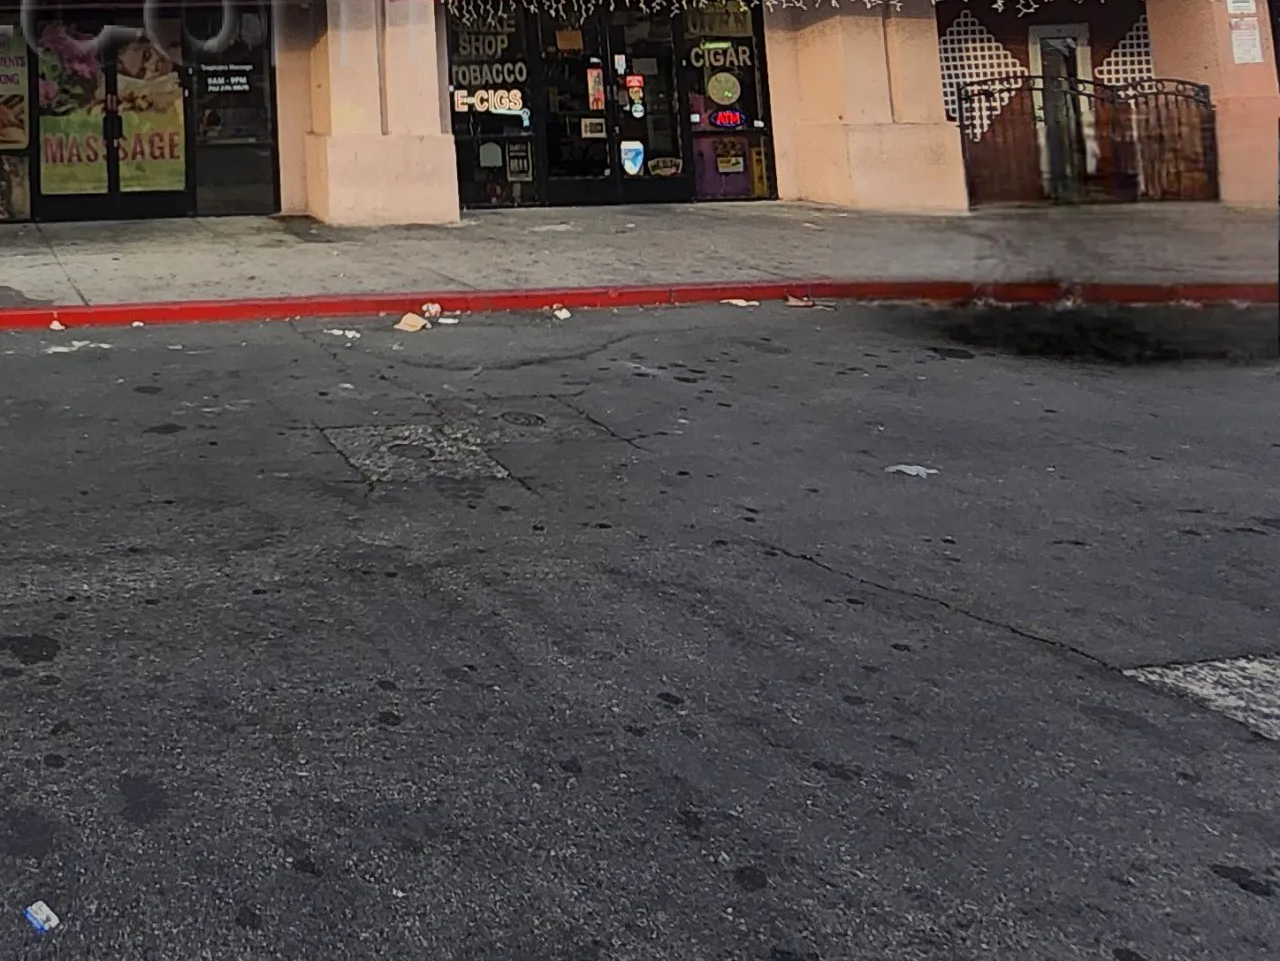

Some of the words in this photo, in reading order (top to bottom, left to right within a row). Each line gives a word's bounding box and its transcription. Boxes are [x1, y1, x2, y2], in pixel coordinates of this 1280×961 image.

[459, 34, 508, 58] SHOP
[690, 46, 751, 68] CIGAR
[452, 62, 527, 86] TOBACCO
[454, 88, 523, 112] E-CIGS
[716, 111, 740, 125] ATM
[43, 131, 181, 165] MASSAGE
